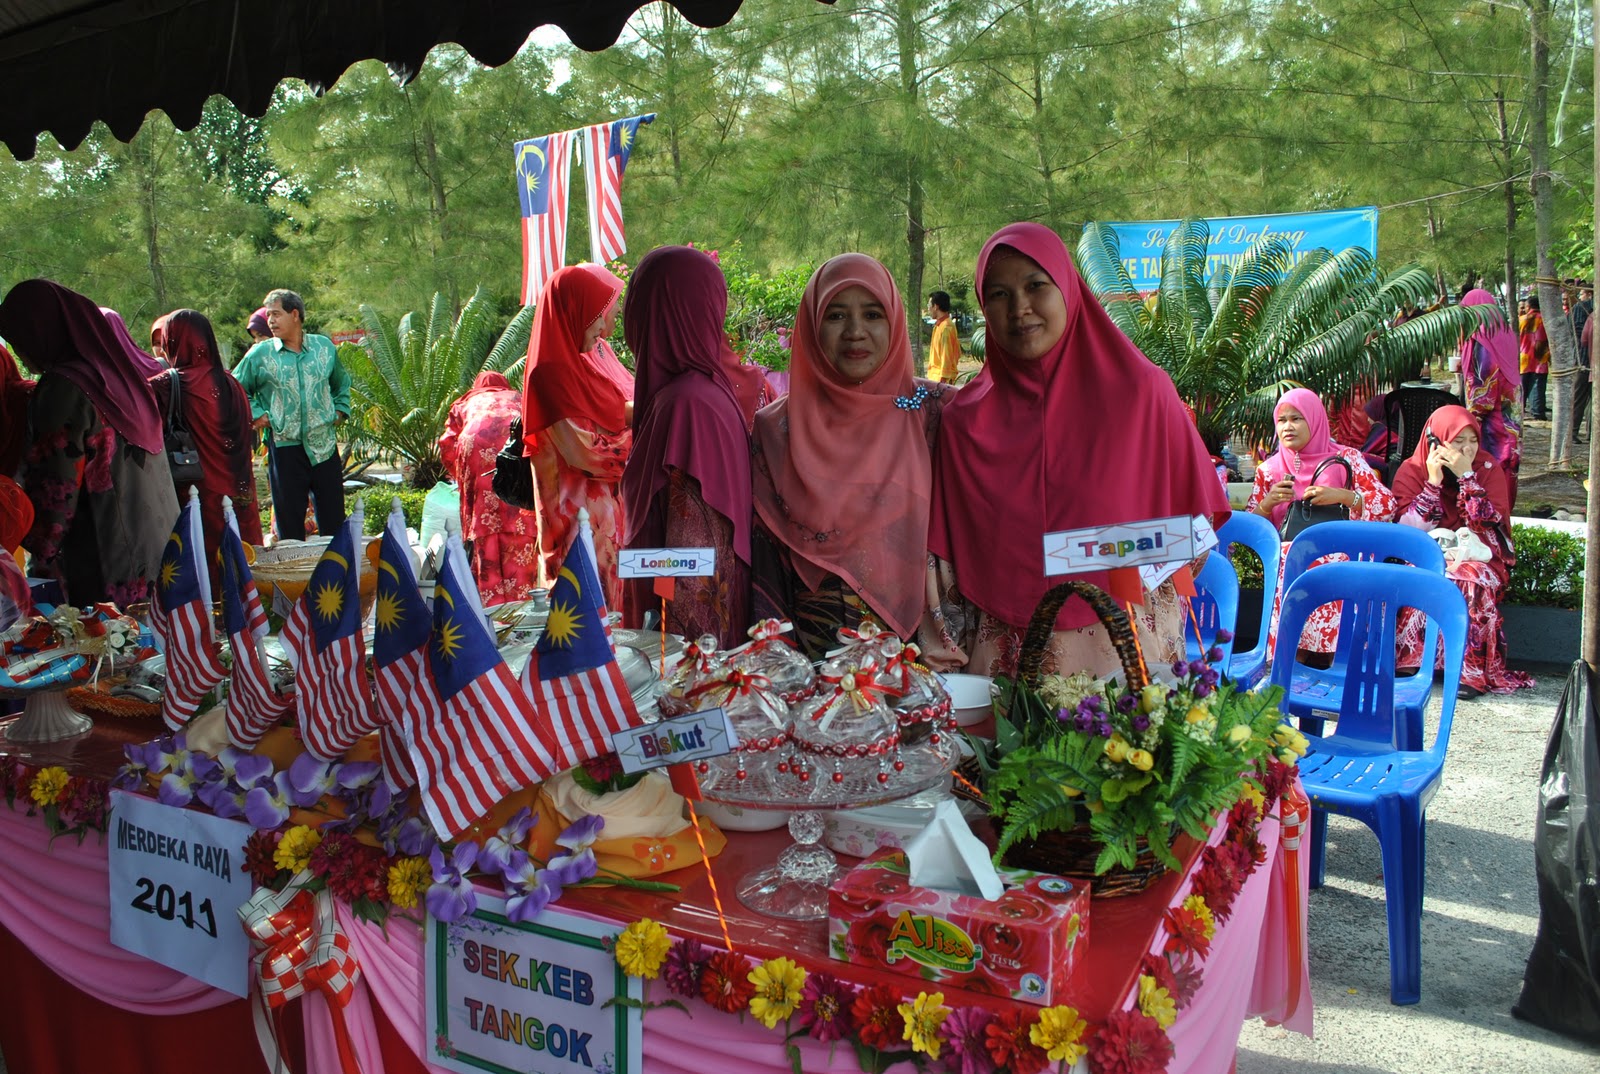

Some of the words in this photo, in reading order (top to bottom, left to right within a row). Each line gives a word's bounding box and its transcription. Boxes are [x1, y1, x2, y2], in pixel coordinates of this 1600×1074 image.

[641, 558, 697, 570] Lontong
[1078, 532, 1163, 557] Tapai
[638, 723, 706, 759] Biskut
[117, 816, 189, 864] MERDEKA
[193, 843, 232, 884] RAYA
[130, 877, 218, 938] 2011
[887, 910, 974, 959] Alisa
[463, 939, 595, 1006] SEK.KEB
[464, 997, 593, 1068] TANGOK
